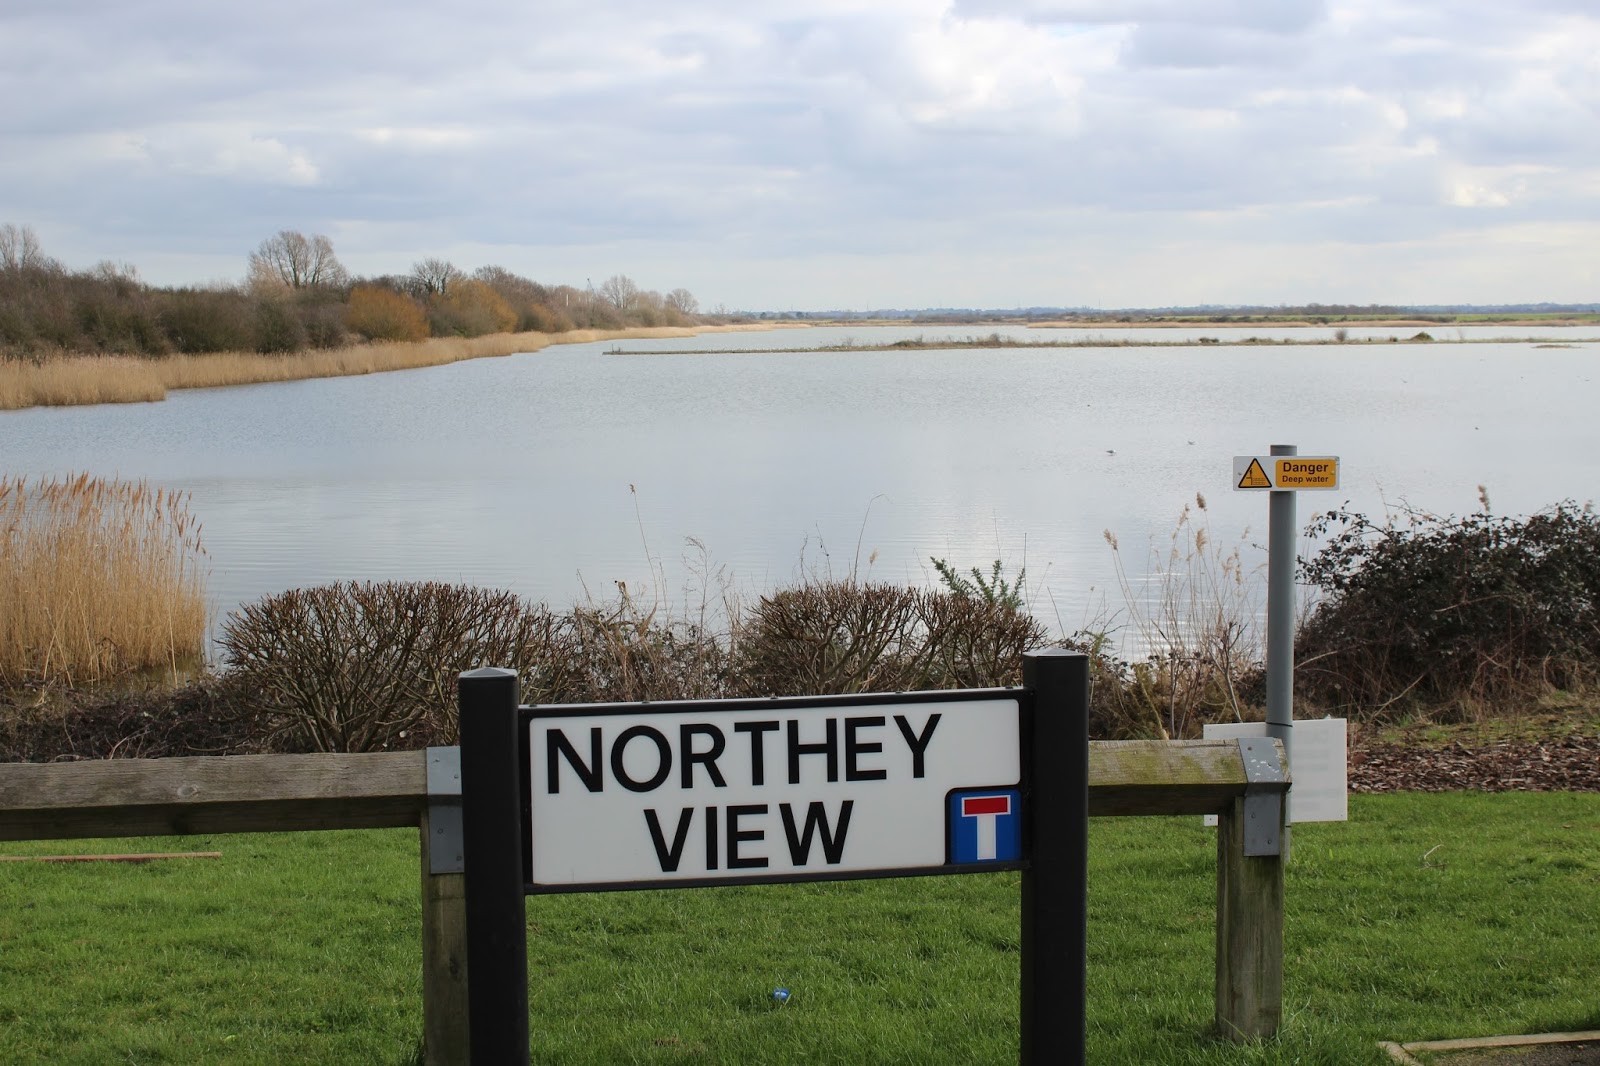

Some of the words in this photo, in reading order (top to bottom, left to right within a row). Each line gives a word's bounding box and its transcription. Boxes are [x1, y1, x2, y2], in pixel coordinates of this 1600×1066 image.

[1282, 475, 1304, 484] Deep
[1283, 462, 1329, 475] Danger
[546, 713, 943, 794] NORTHEY
[643, 800, 855, 873] VIEW
